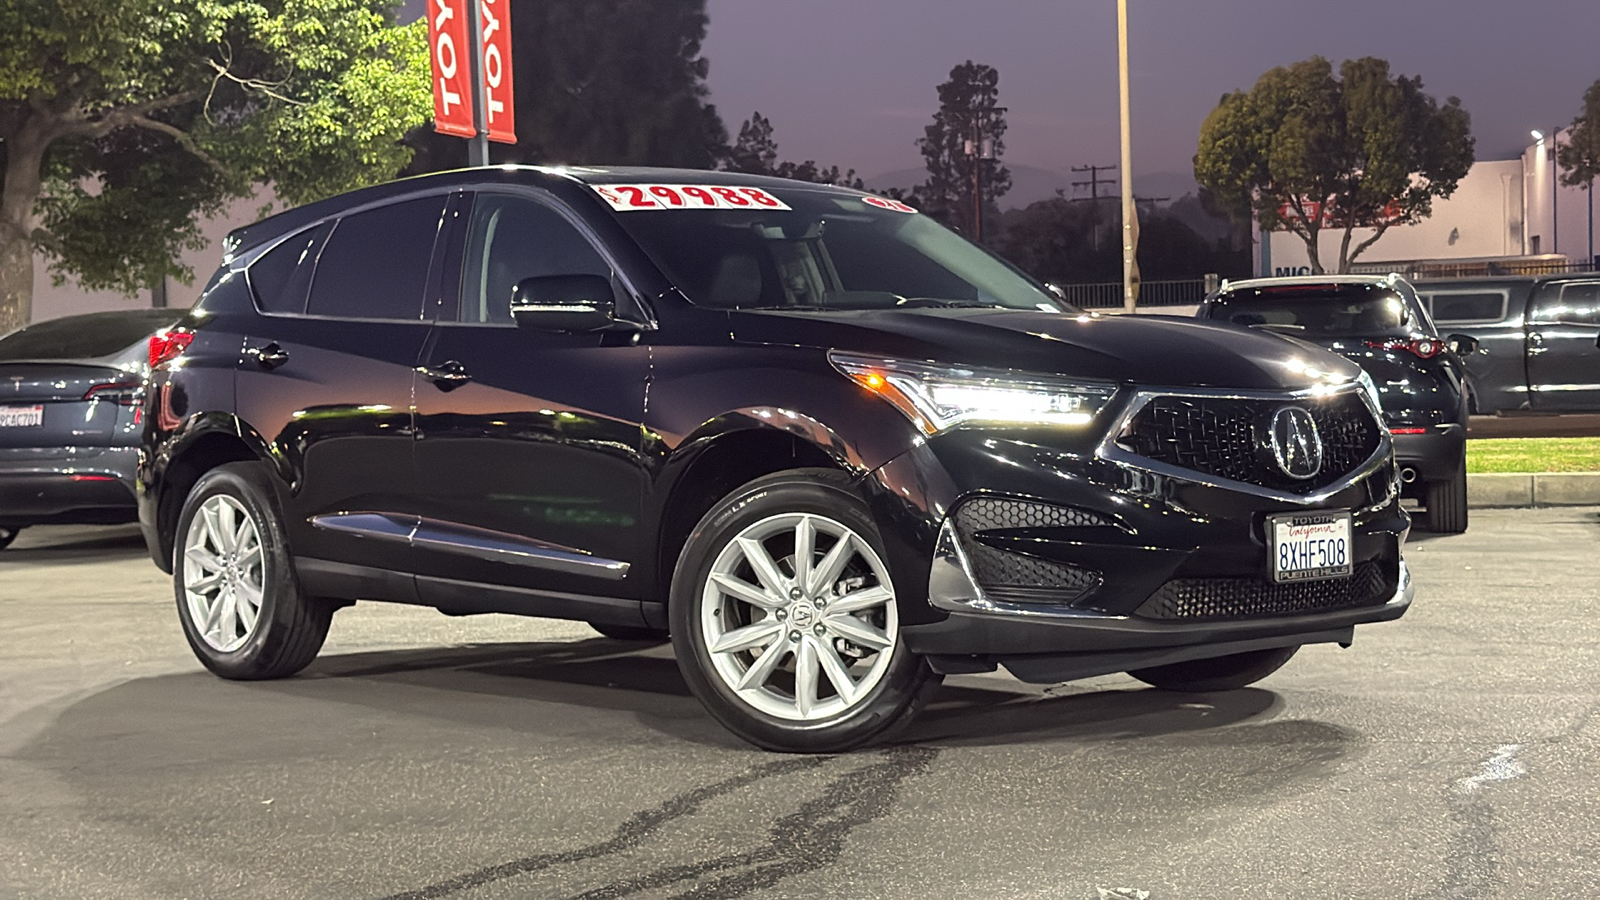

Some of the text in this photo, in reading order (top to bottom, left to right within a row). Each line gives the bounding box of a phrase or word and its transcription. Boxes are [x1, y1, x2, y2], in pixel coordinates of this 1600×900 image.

[482, 0, 504, 124] TOY
[598, 185, 780, 208] $29988
[1276, 266, 1315, 277] MIC
[1279, 537, 1346, 571] 8XHF508
[1280, 569, 1320, 580] PUENTE
